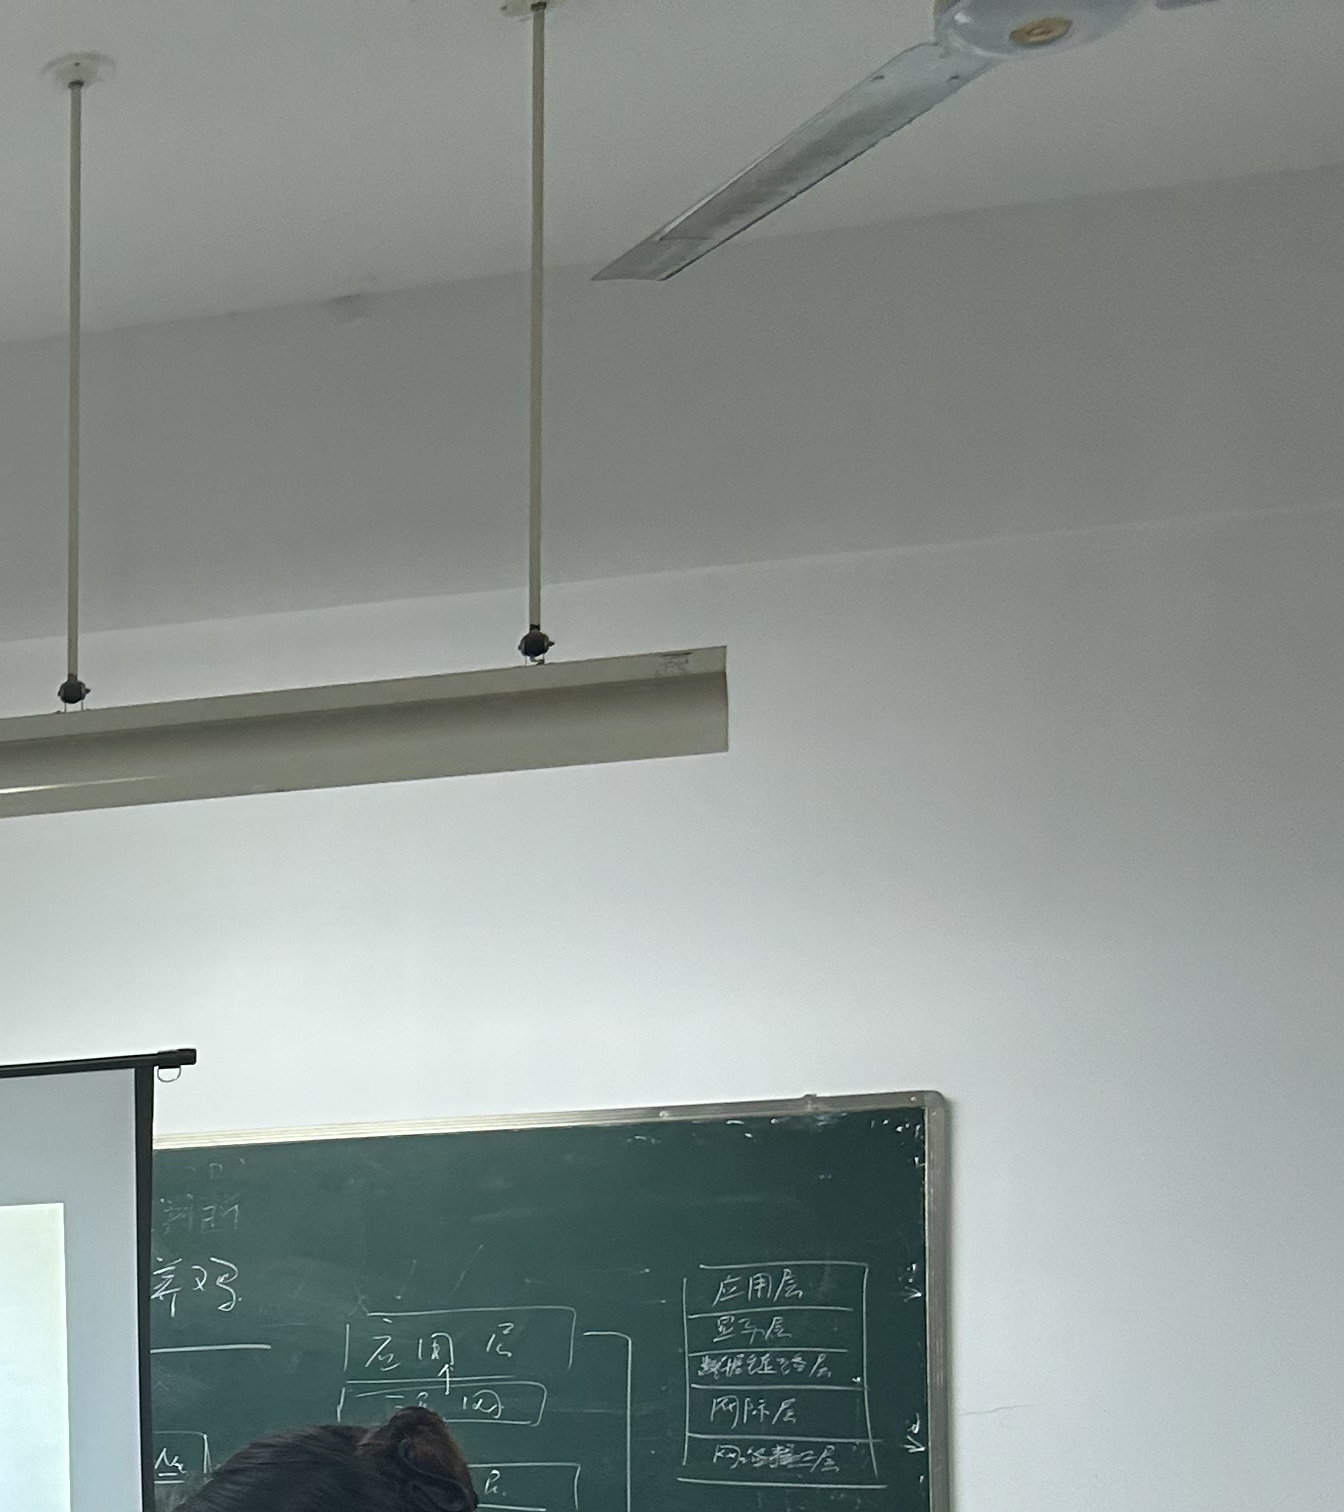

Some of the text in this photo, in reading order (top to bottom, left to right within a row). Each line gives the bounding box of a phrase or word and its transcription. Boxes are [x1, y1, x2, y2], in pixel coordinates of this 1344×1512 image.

[712, 1268, 804, 1305] 应用层
[710, 1395, 797, 1429] 网际层
